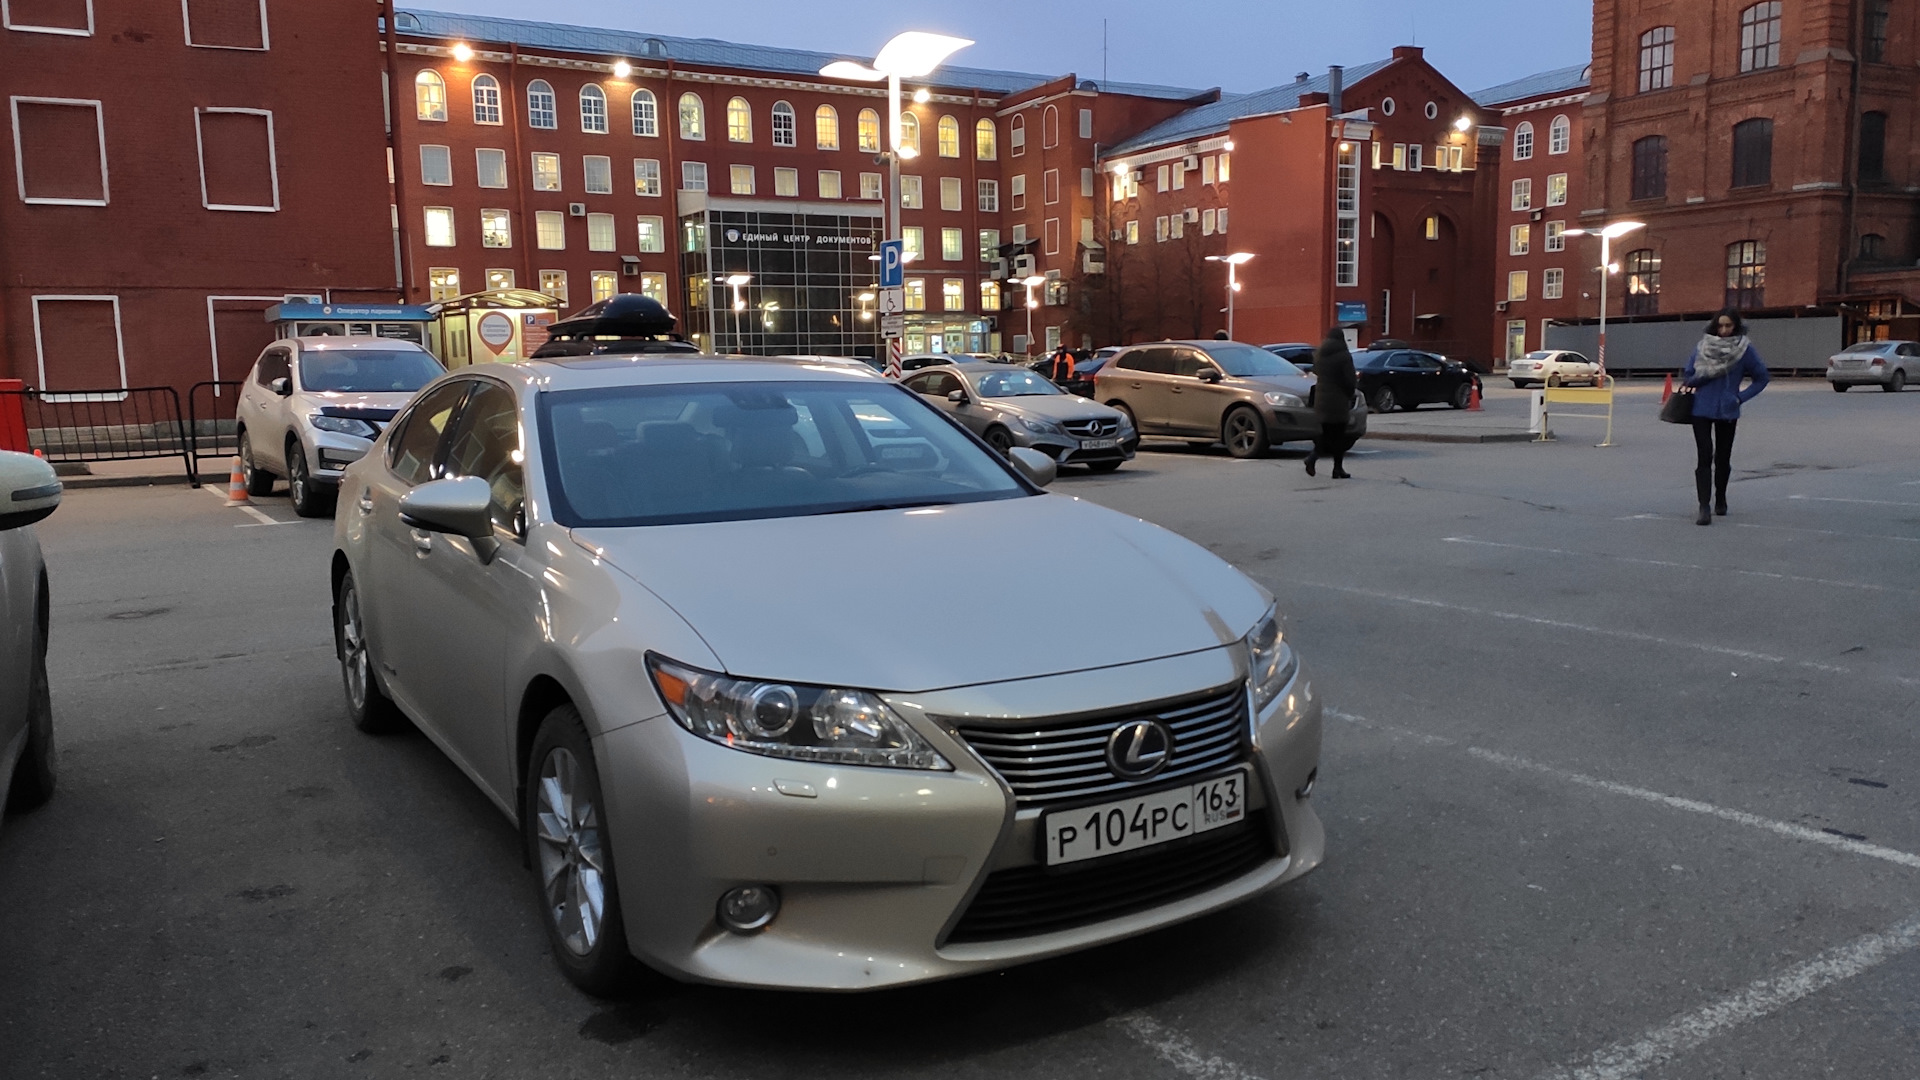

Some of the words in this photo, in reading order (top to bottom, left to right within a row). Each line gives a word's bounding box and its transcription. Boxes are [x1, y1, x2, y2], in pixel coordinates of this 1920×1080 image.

[742, 232, 778, 242] ЕДИНЫЙ
[783, 234, 810, 244] ЦЕНТР
[816, 235, 871, 245] ДОКУМЕНТОВ
[885, 245, 899, 283] P
[1196, 779, 1237, 815] 163
[1204, 810, 1226, 825] RUS
